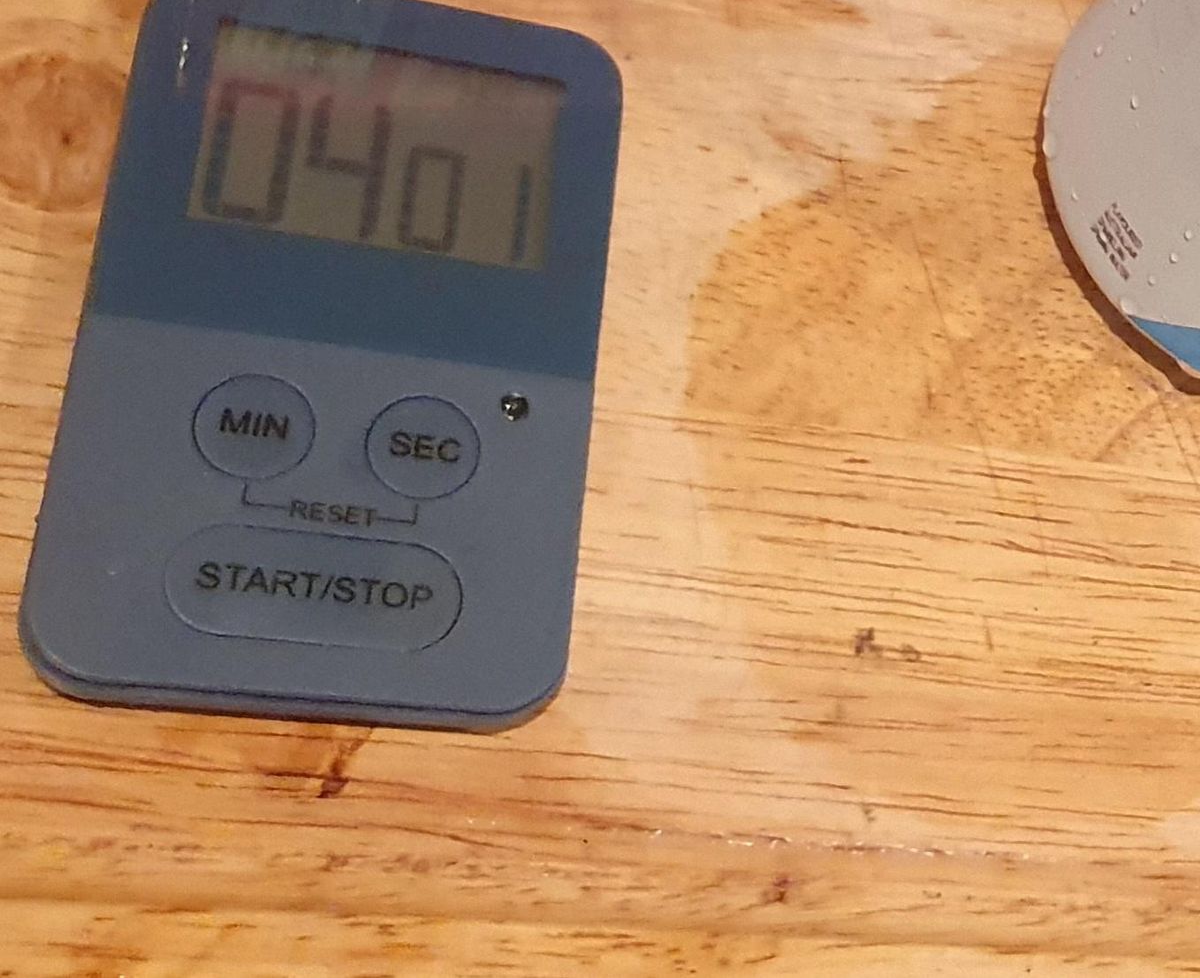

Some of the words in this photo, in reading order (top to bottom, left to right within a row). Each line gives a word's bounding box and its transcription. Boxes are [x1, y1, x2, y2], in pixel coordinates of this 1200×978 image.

[217, 407, 291, 440] MIN
[389, 430, 463, 464] SEC
[288, 498, 379, 526] RESET
[195, 561, 435, 610] START/STOP
